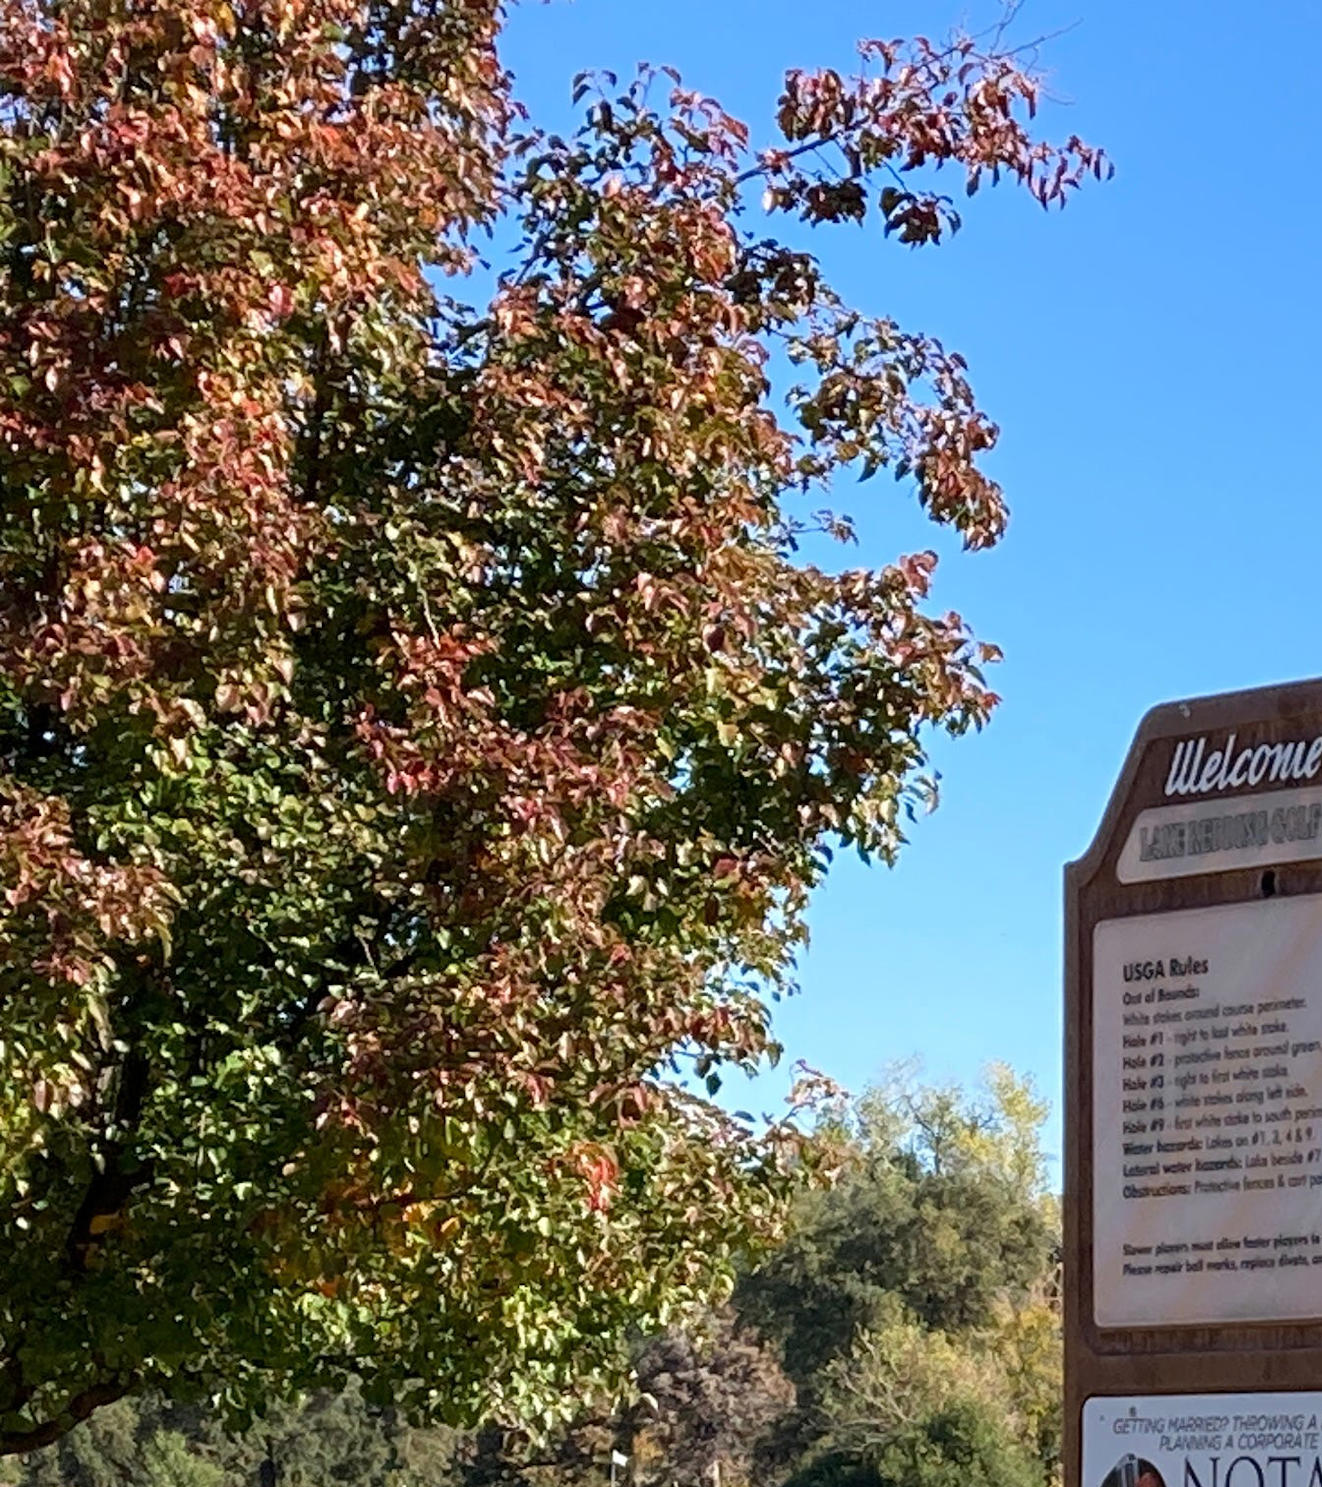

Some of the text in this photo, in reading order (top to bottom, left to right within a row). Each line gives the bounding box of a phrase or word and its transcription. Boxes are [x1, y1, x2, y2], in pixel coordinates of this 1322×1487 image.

[1122, 955, 1209, 982] USGA Rules
[1113, 1416, 1165, 1435] GETTING
[1168, 1414, 1229, 1433] MARRIED?
[1232, 1412, 1305, 1433] THROWING
[1307, 1413, 1319, 1430] A
[1159, 1434, 1223, 1451] PLANNING
[1224, 1434, 1235, 1450] A
[1238, 1431, 1320, 1450] CORPORATE
